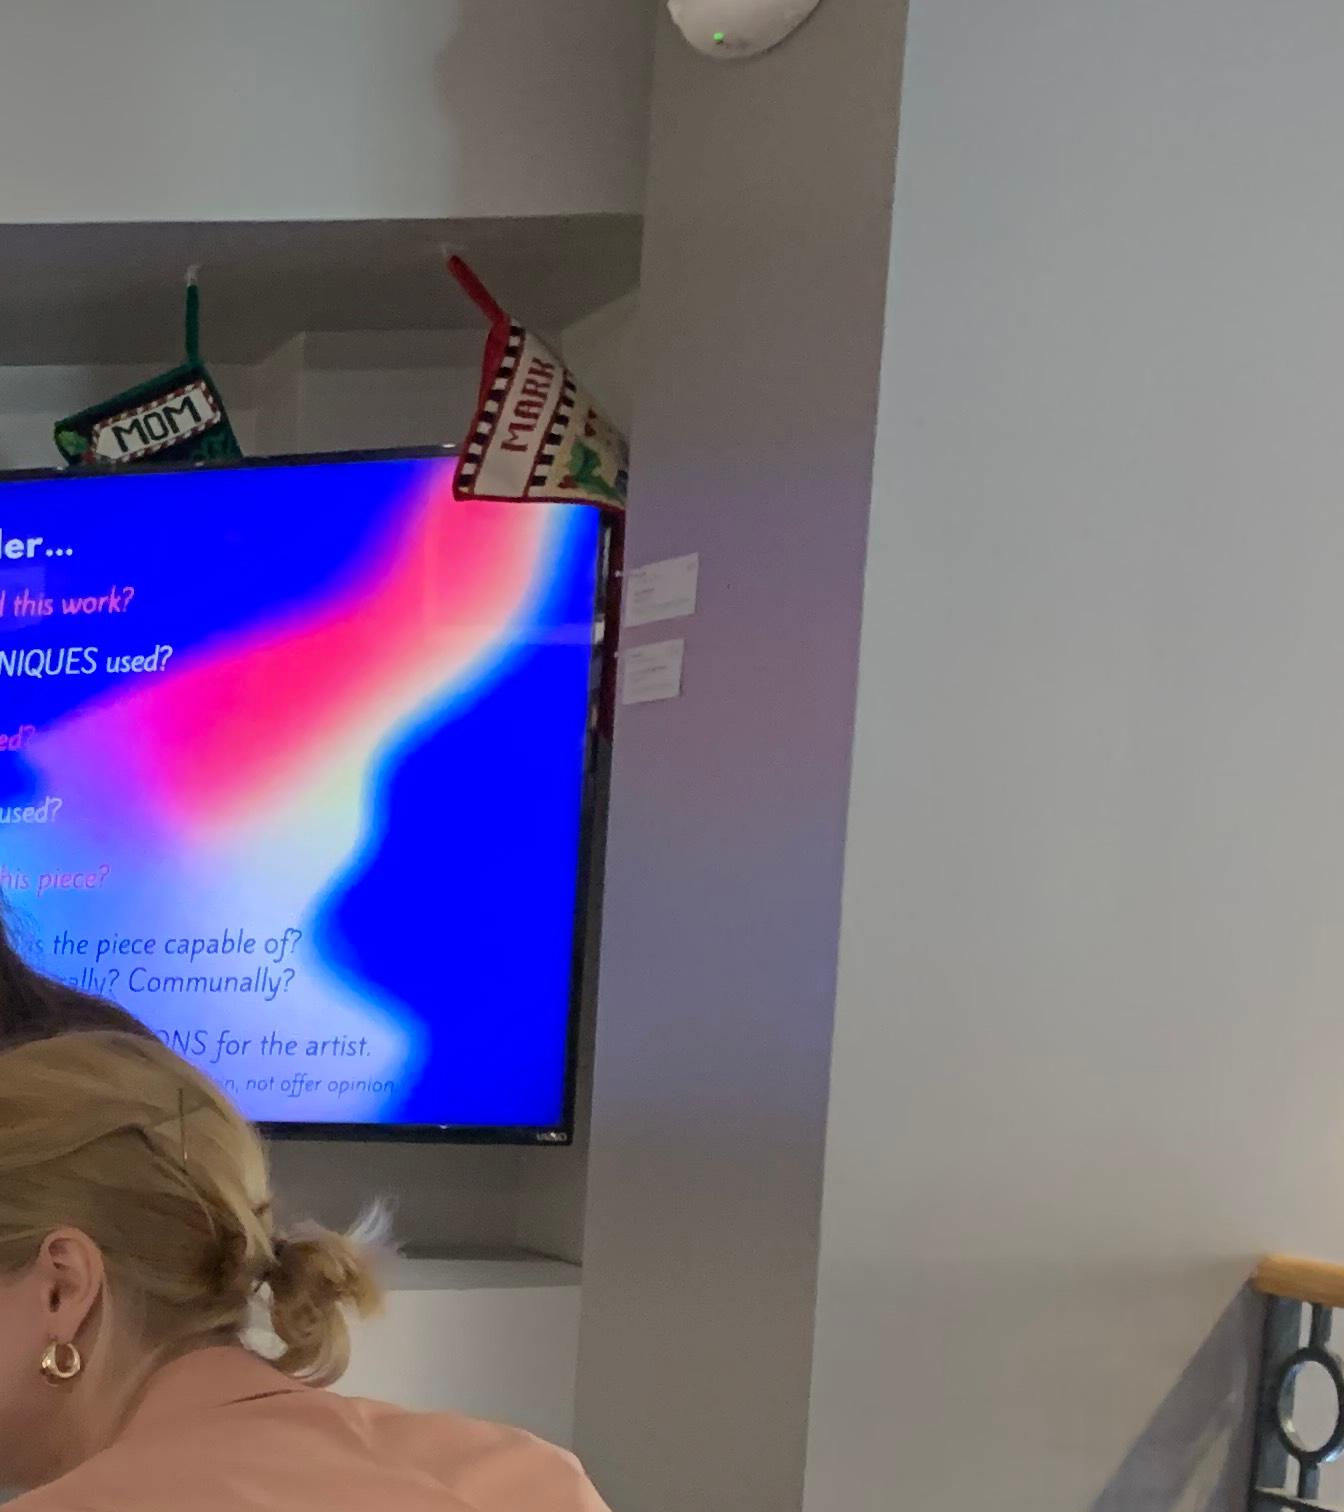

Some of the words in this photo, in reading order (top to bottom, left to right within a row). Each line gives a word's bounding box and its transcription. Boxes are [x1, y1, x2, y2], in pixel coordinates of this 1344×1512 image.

[500, 357, 556, 452] MARK
[113, 395, 202, 453] MOM
[14, 587, 53, 617] this
[62, 585, 135, 615] work?
[106, 644, 174, 673] used?
[37, 863, 111, 897] piece?
[53, 930, 88, 955] the
[95, 932, 156, 963] piece
[164, 928, 256, 963] capable
[265, 927, 302, 963] of?
[129, 967, 296, 1002] Communally?
[210, 1030, 251, 1063] for
[260, 1031, 298, 1056] the
[305, 1030, 371, 1057] artist.
[246, 1076, 275, 1092] not
[280, 1072, 322, 1098] offer
[327, 1077, 396, 1098] opinion
